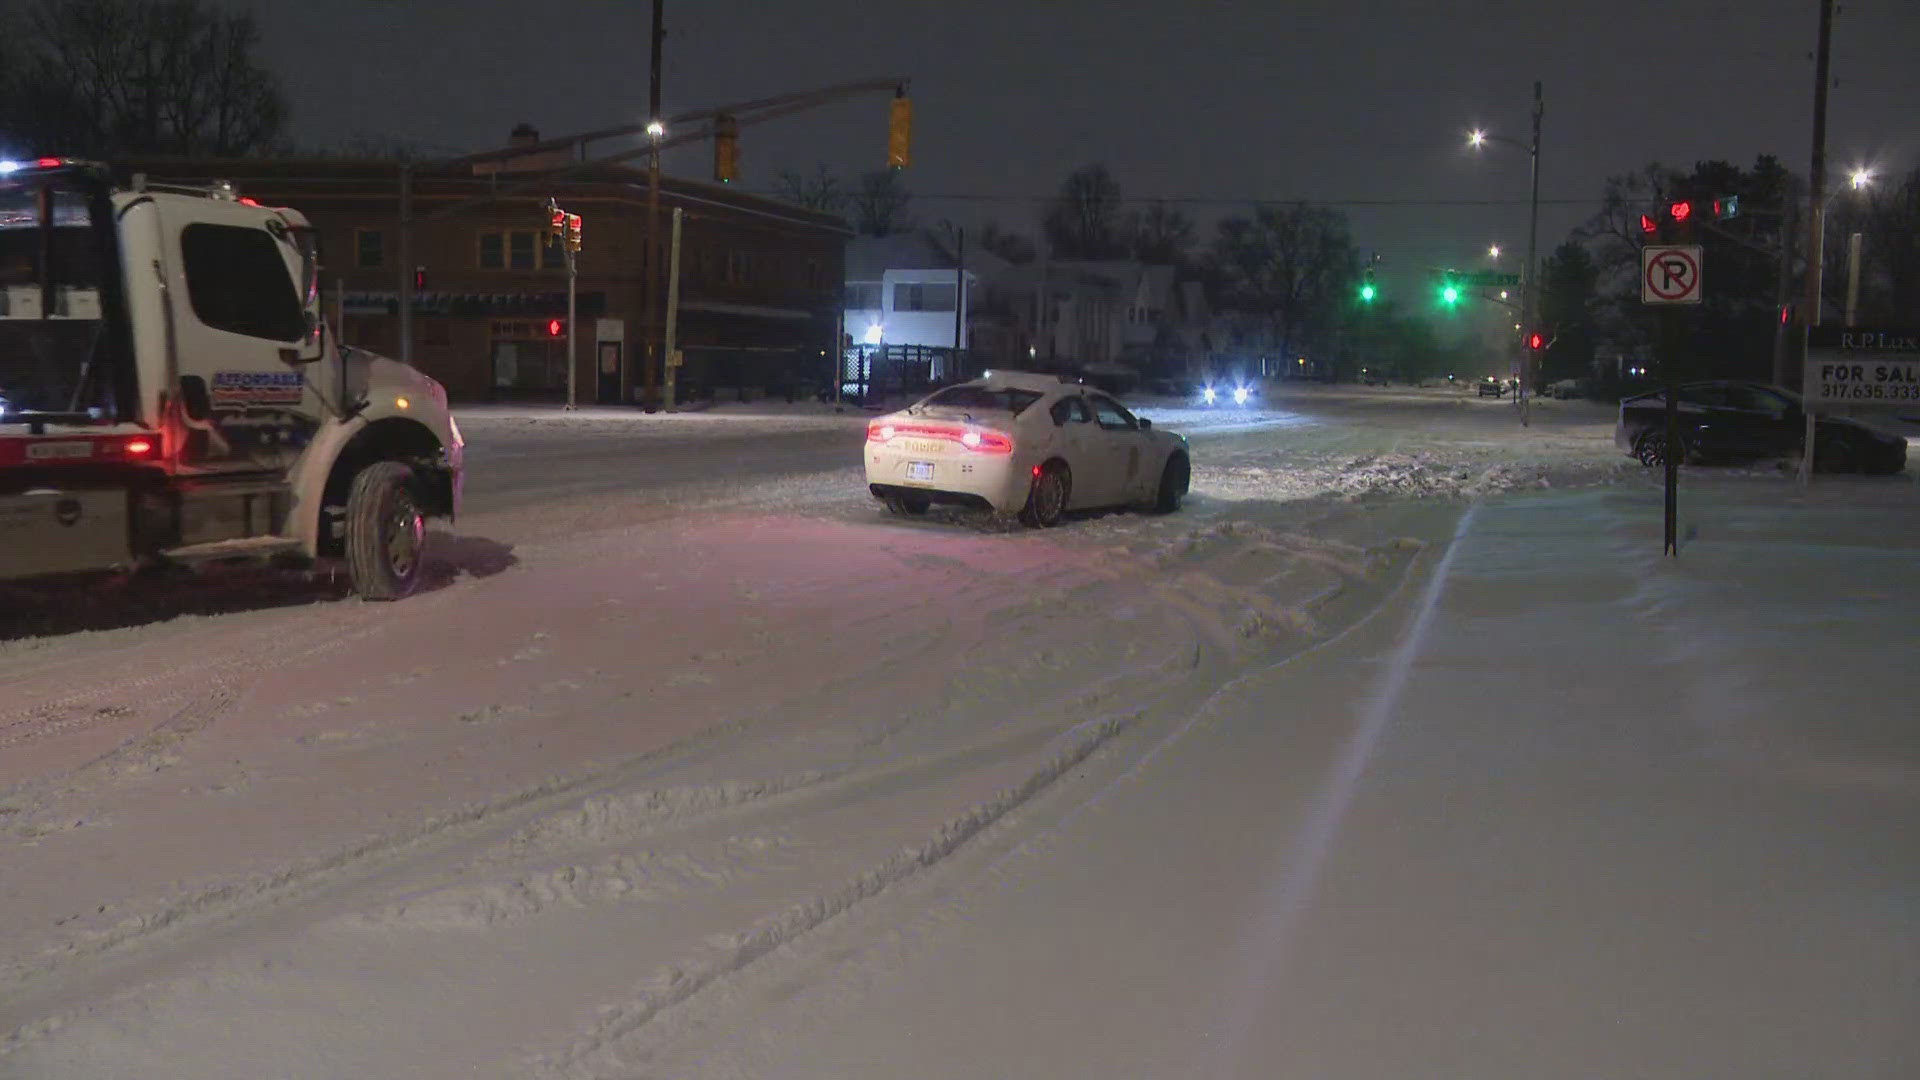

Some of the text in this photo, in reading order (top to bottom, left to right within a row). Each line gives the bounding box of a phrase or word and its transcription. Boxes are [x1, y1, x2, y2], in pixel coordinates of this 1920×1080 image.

[215, 372, 304, 387] AFFORDABLE
[1821, 364, 1864, 382] FOR
[904, 440, 945, 452] POLICE
